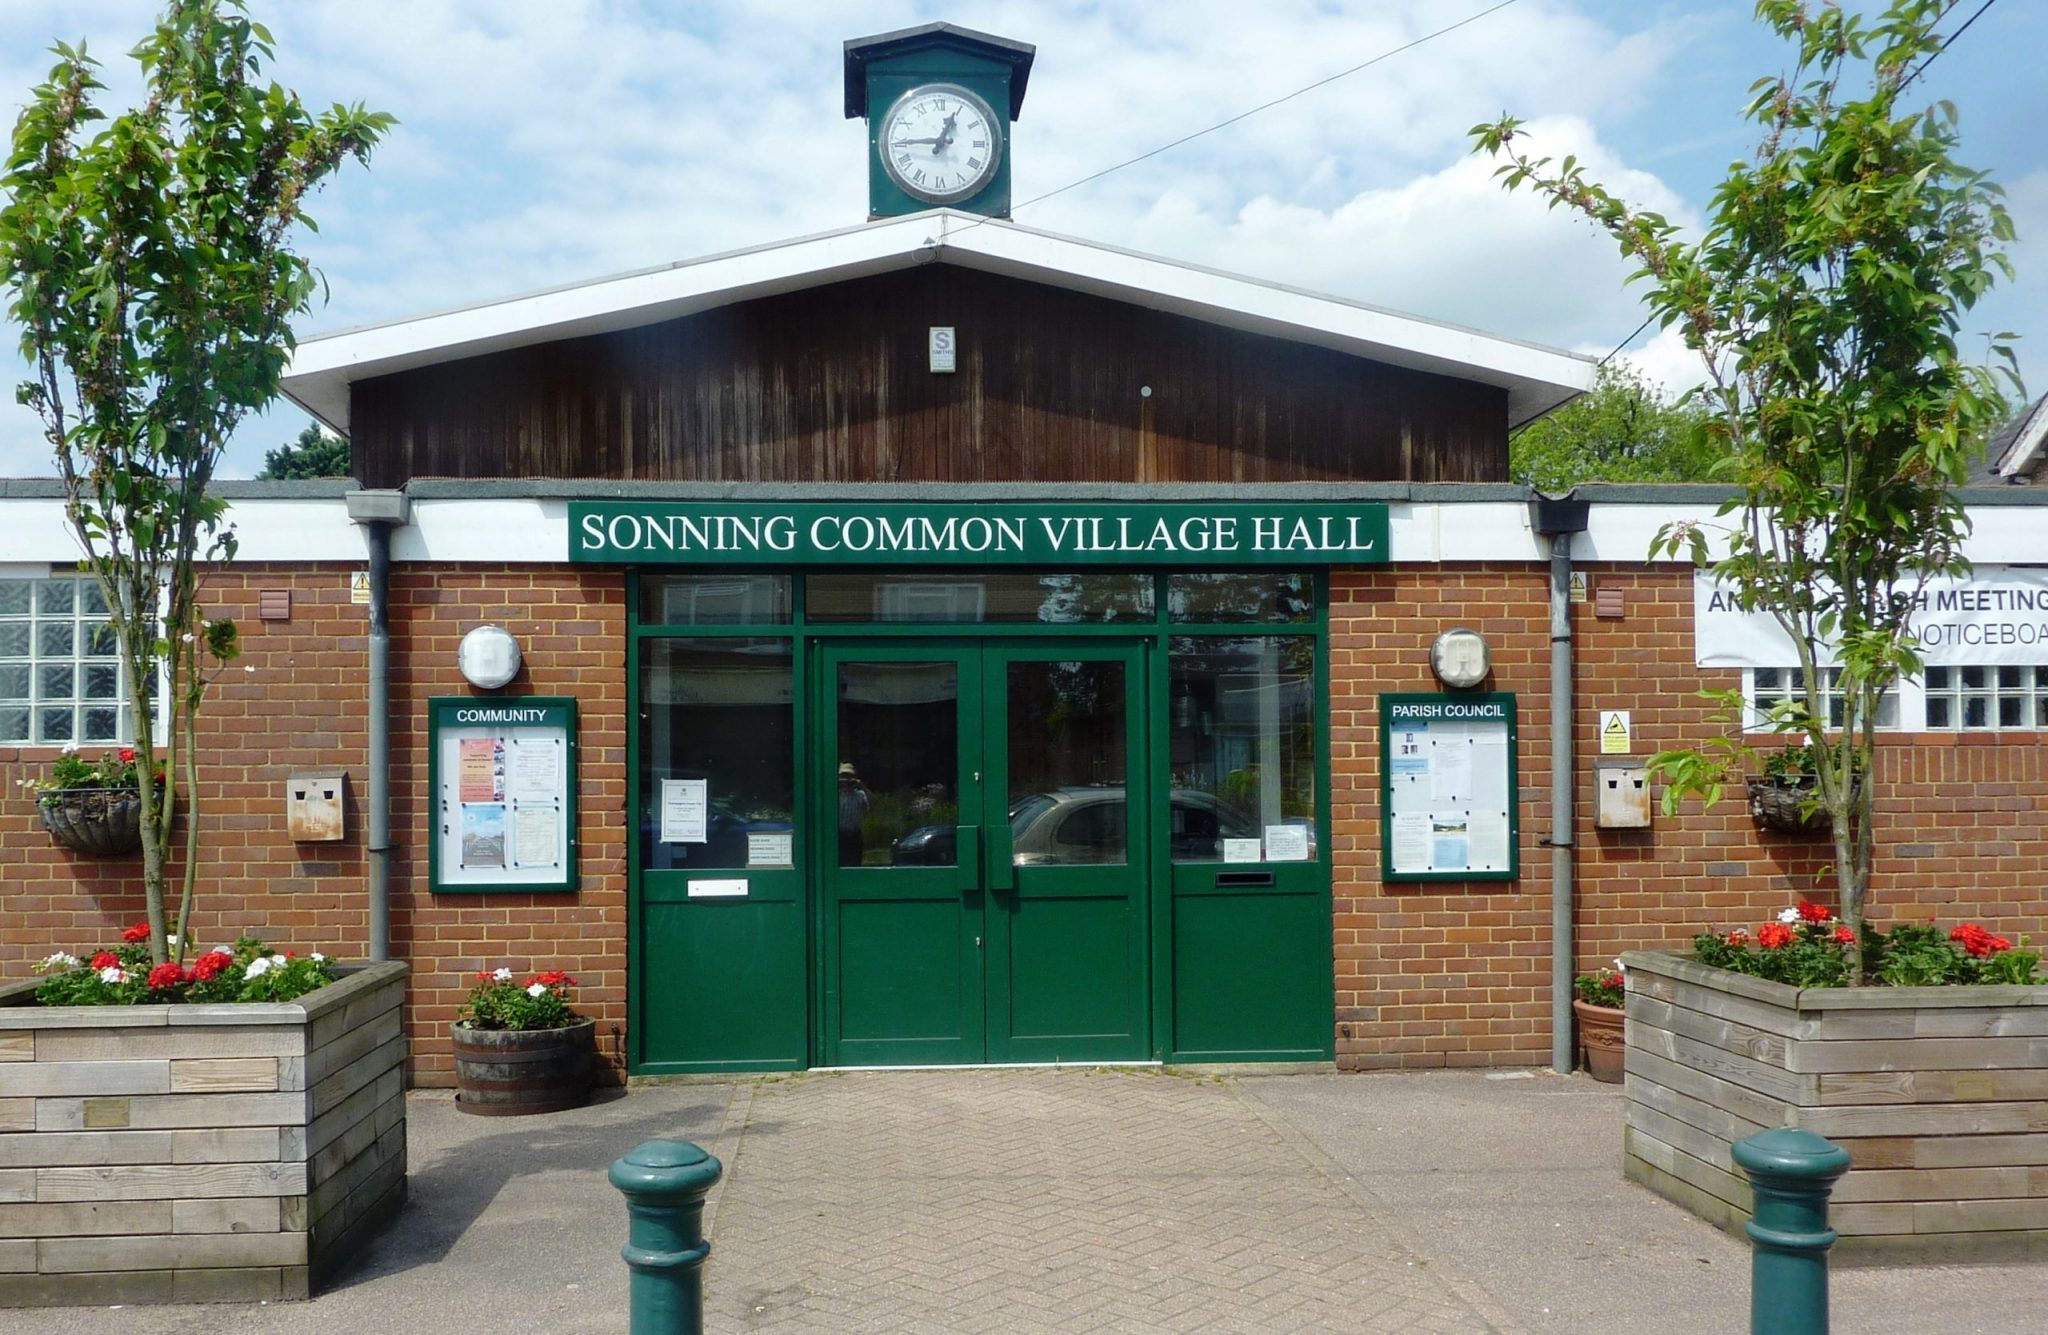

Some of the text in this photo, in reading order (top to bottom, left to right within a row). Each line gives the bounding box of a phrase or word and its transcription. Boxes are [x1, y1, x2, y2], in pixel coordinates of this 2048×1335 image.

[581, 514, 1375, 552] SONNING COMMON VILLAGE HALL
[456, 709, 547, 722] COMMUNITY
[1392, 704, 1505, 717] PARISH COUNCIL
